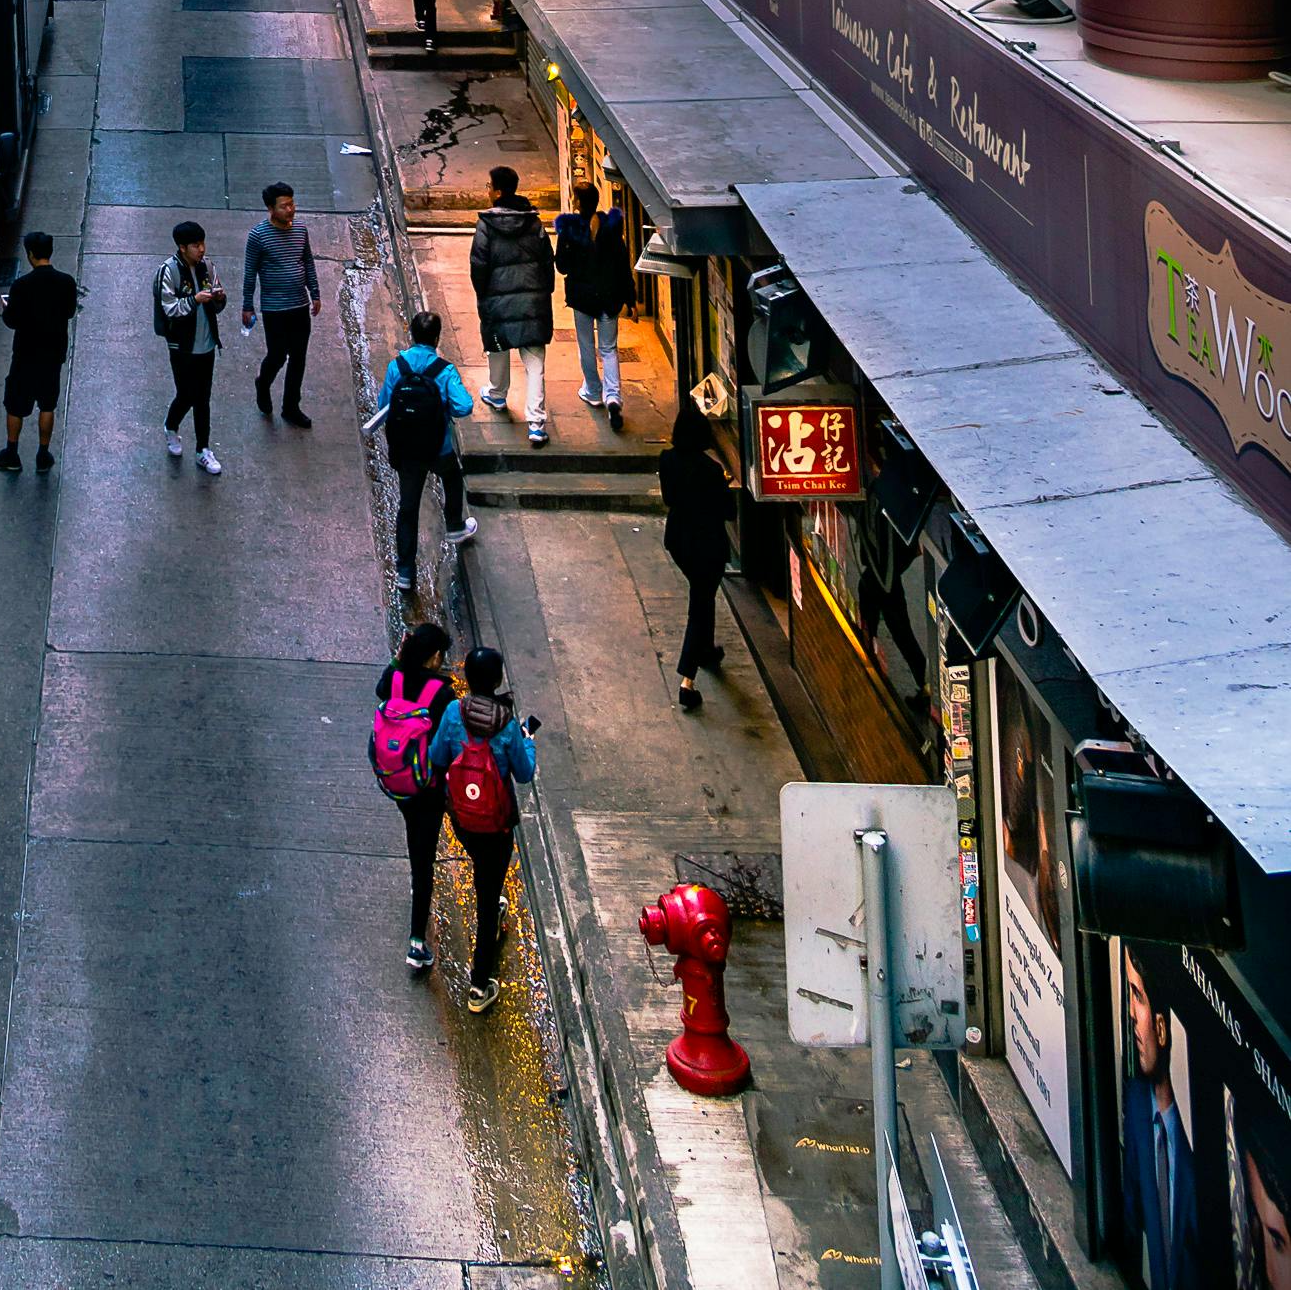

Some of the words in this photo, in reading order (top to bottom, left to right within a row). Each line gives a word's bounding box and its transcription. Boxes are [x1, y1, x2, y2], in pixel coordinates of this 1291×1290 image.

[927, 56, 938, 108] &
[951, 75, 1031, 187] Restaurant
[1185, 272, 1200, 313] 茶
[776, 480, 800, 490] Tsim
[802, 480, 826, 490] Chai
[829, 479, 847, 489] Kee
[1005, 894, 1046, 976] Ermenegildo
[1007, 927, 1023, 966] Loro
[1023, 955, 1042, 1000] Piana
[1182, 944, 1242, 1047] BAHAMAS
[1011, 1024, 1035, 1081] Cerruti
[817, 1142, 844, 1152] Wharf
[844, 1254, 873, 1265] Wharf
